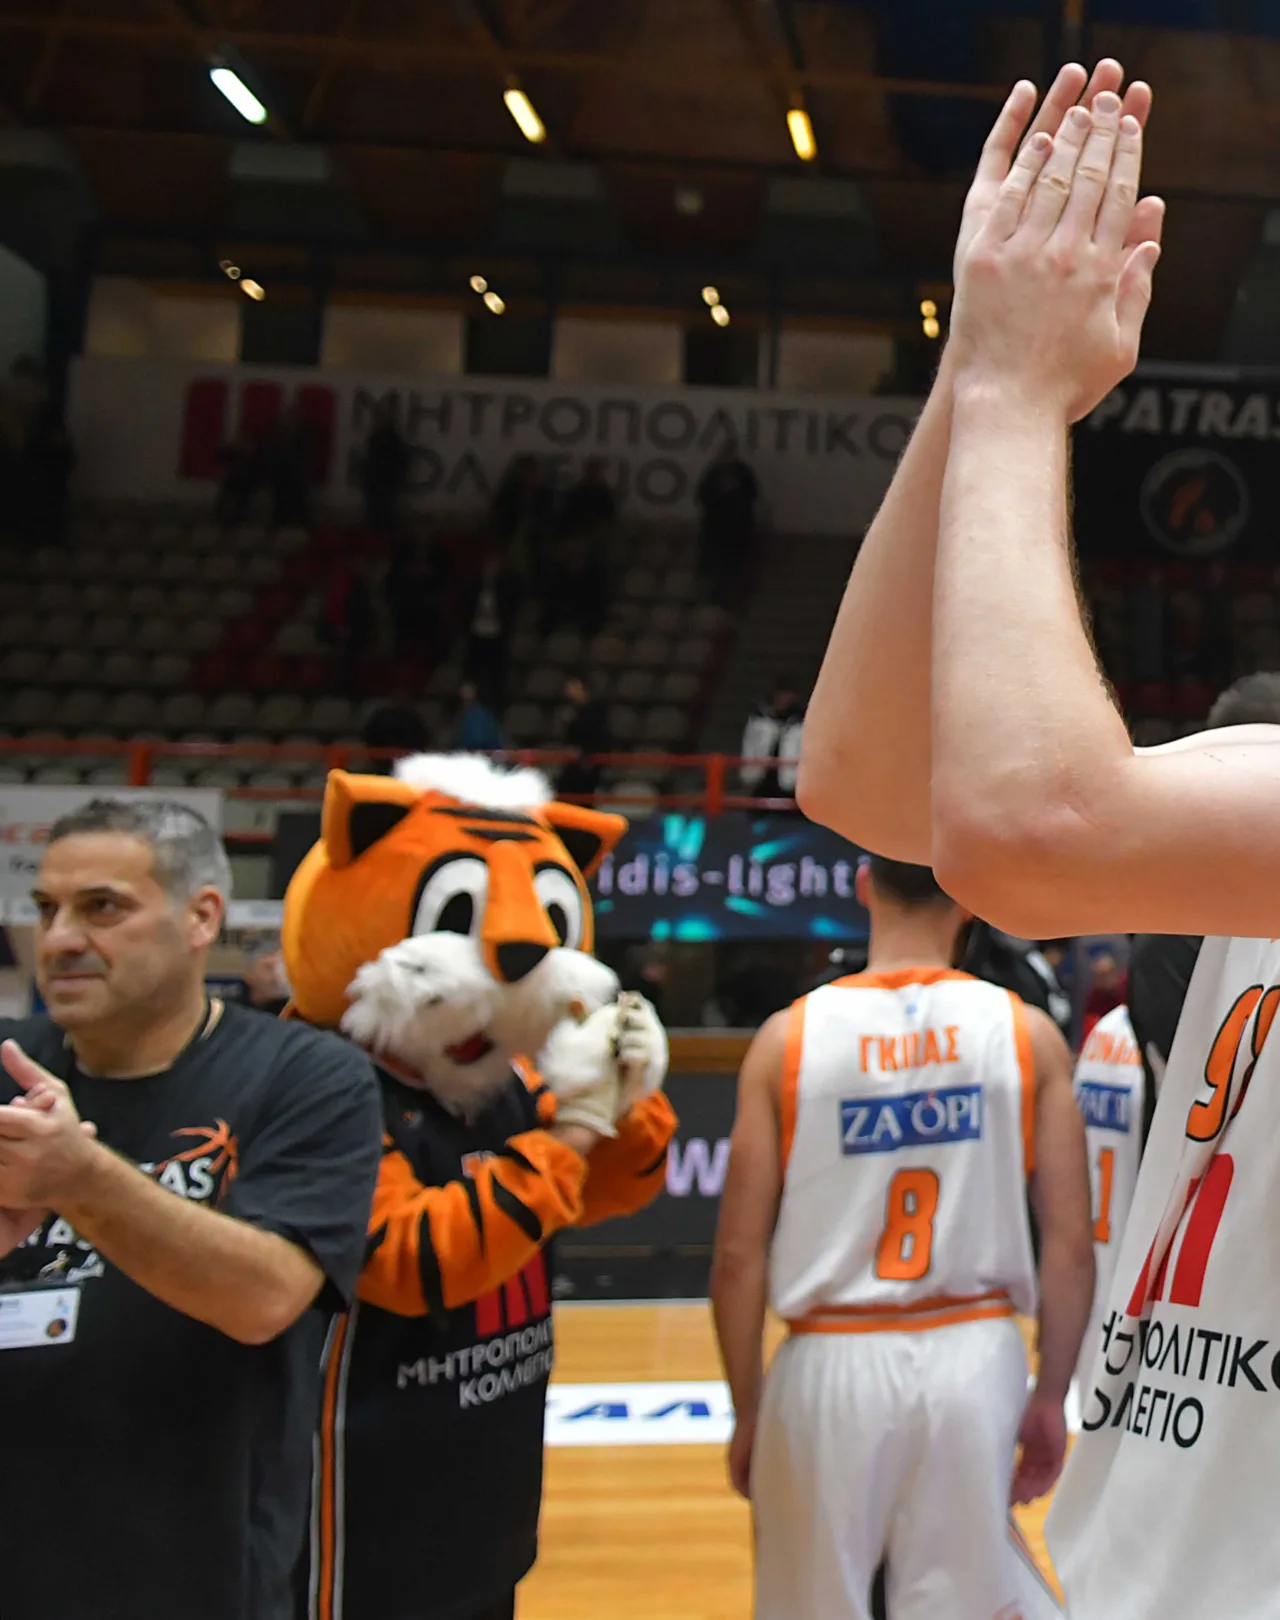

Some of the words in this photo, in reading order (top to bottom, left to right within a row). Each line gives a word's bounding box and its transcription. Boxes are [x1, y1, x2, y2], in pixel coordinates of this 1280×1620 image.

[597, 851, 871, 906] idis-light
[841, 1092, 980, 1145] ΖΑΟΡΙ
[873, 1166, 940, 1281] 8
